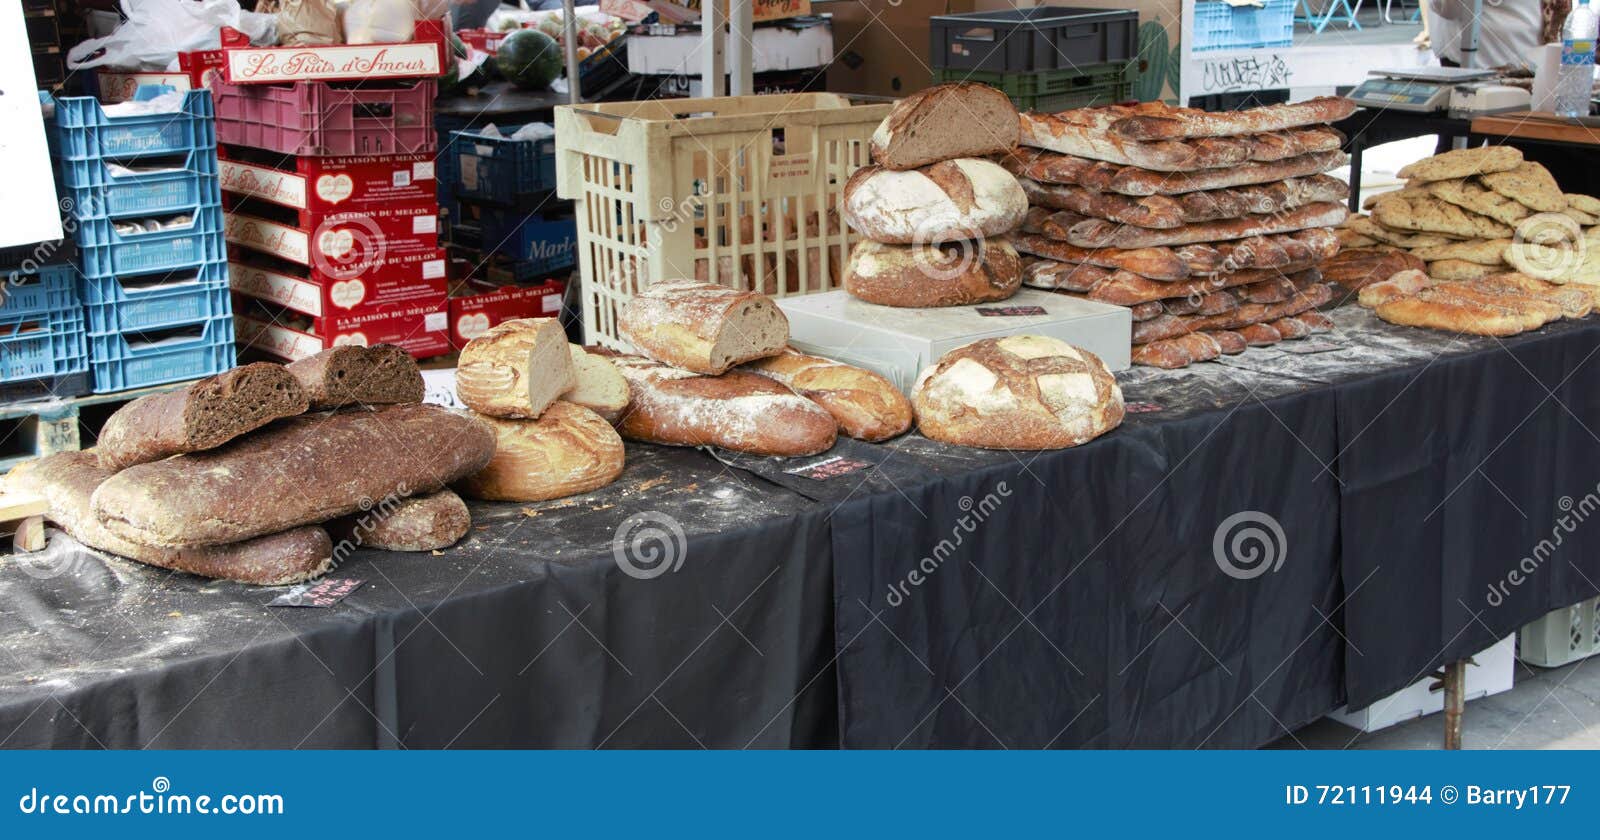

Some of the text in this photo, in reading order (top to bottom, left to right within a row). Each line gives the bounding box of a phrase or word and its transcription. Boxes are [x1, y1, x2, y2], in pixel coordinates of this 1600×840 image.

[338, 156, 377, 164] MAISON
[395, 208, 428, 216] MELON
[404, 252, 437, 262] MELON
[476, 294, 510, 304] MAISON
[512, 291, 524, 299] DU
[526, 287, 555, 296] MELON
[337, 305, 440, 326] LA MAISON DU MELON
